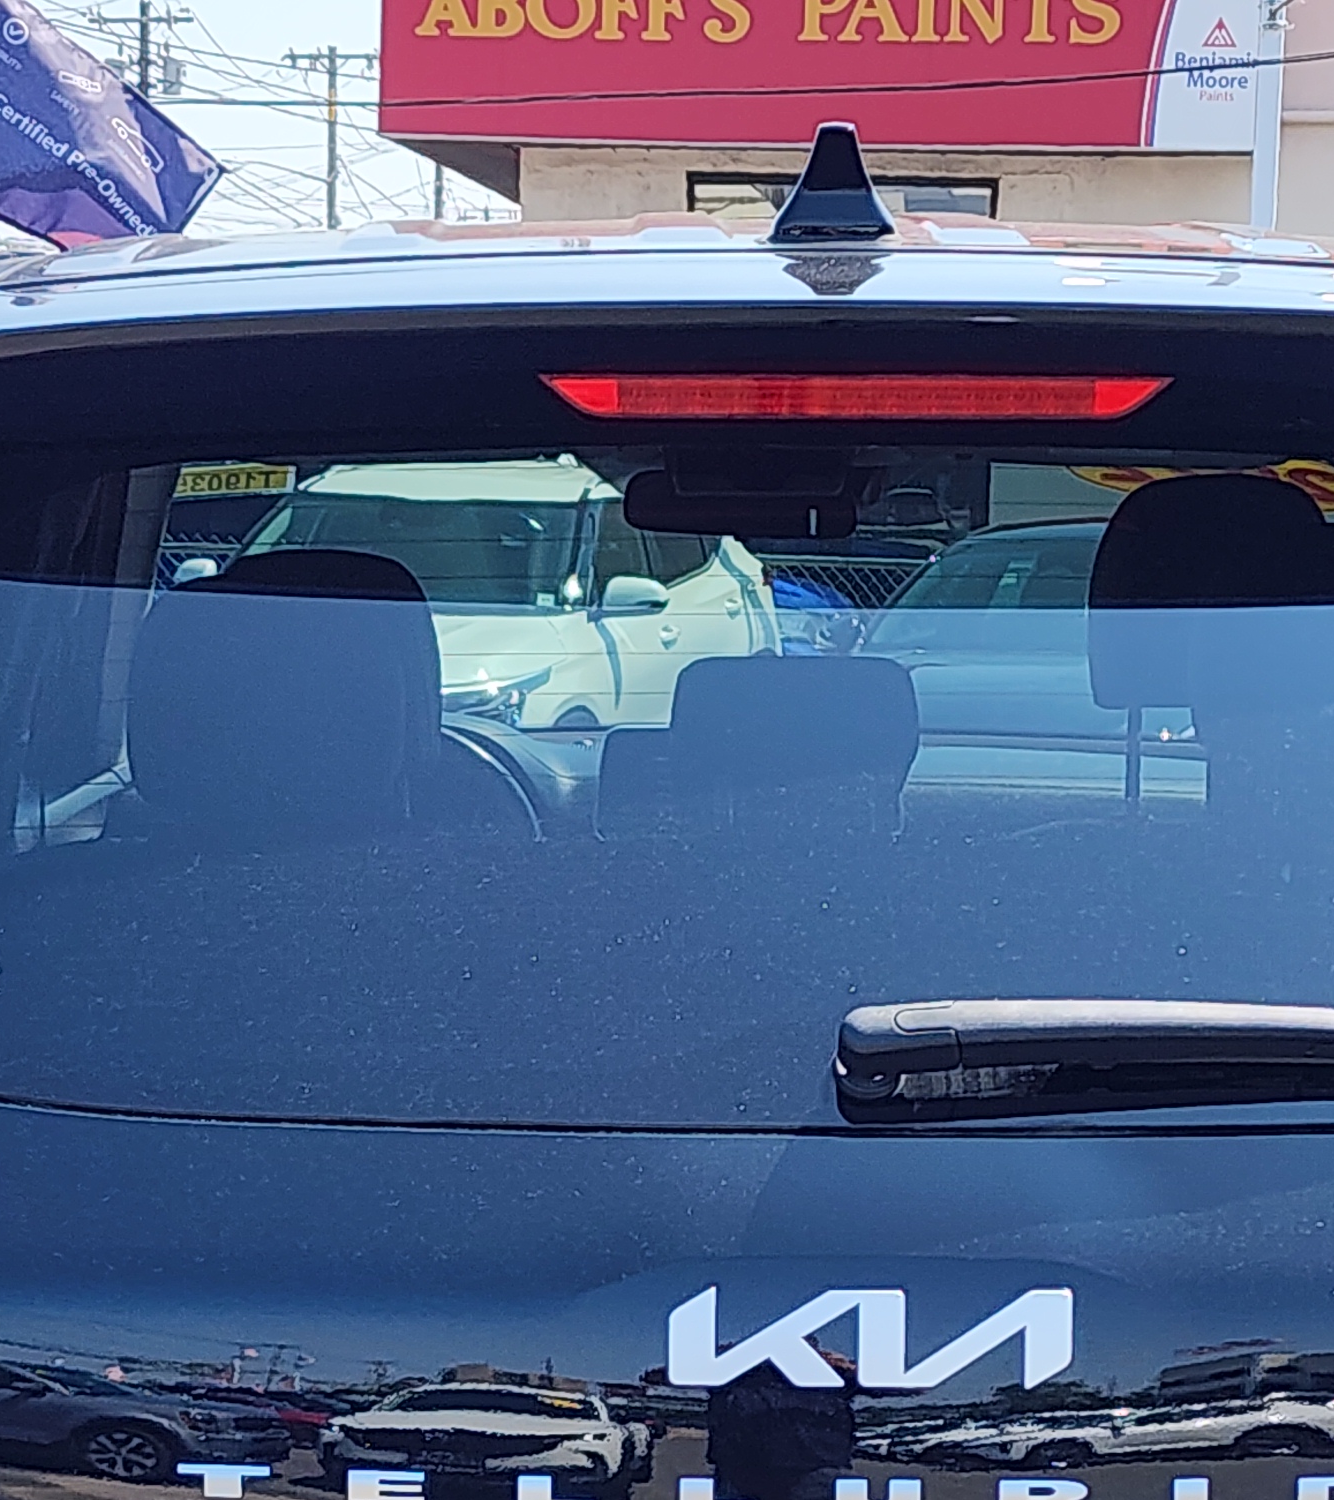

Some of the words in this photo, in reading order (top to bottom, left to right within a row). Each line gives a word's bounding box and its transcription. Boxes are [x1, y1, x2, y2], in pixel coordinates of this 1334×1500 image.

[415, 0, 751, 43] ABOFFS
[797, 0, 1122, 44] PAINTS
[1175, 51, 1255, 73] Benjami
[1187, 71, 1248, 89] Moore
[1199, 90, 1234, 101] Paints
[669, 1286, 1074, 1391] KIA
